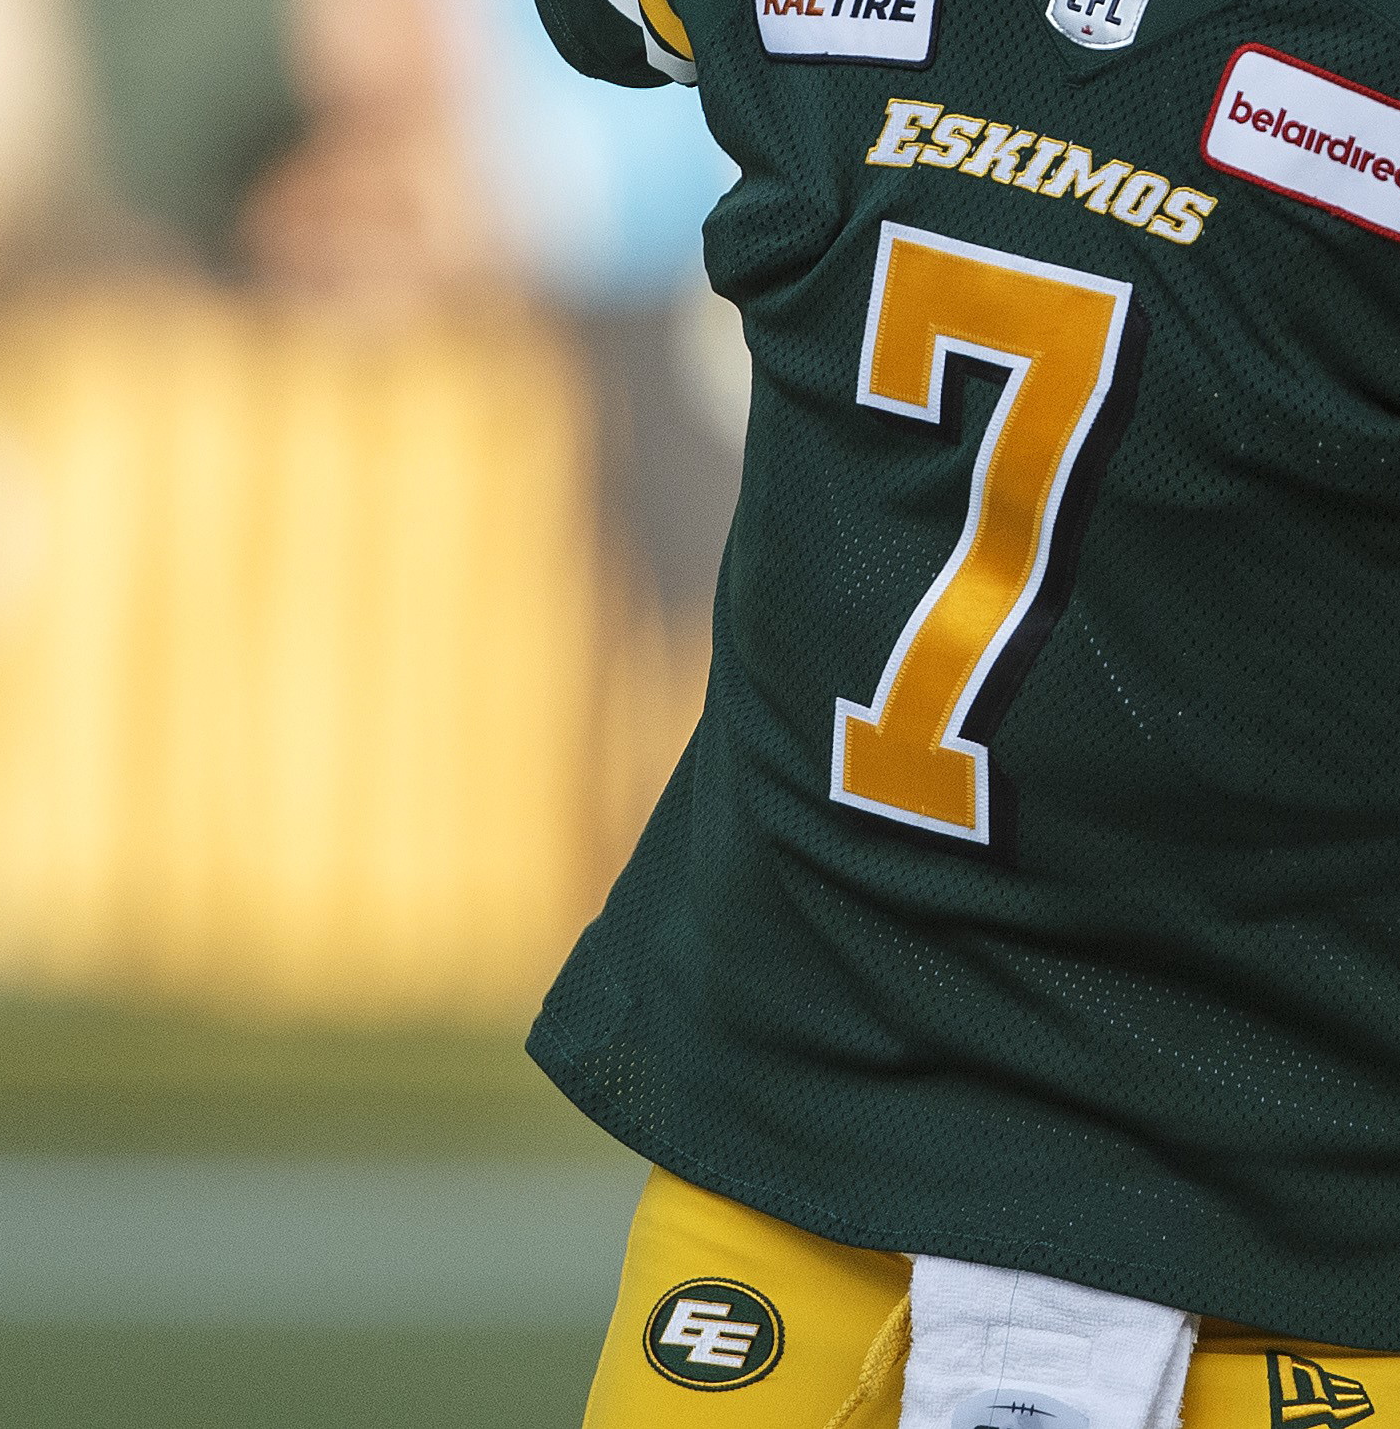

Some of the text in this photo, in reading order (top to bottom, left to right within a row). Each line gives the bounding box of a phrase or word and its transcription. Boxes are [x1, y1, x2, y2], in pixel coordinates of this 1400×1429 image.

[864, 98, 1219, 245] ESKIMOS
[829, 220, 1133, 846] 7
[658, 1298, 761, 1369] EE
